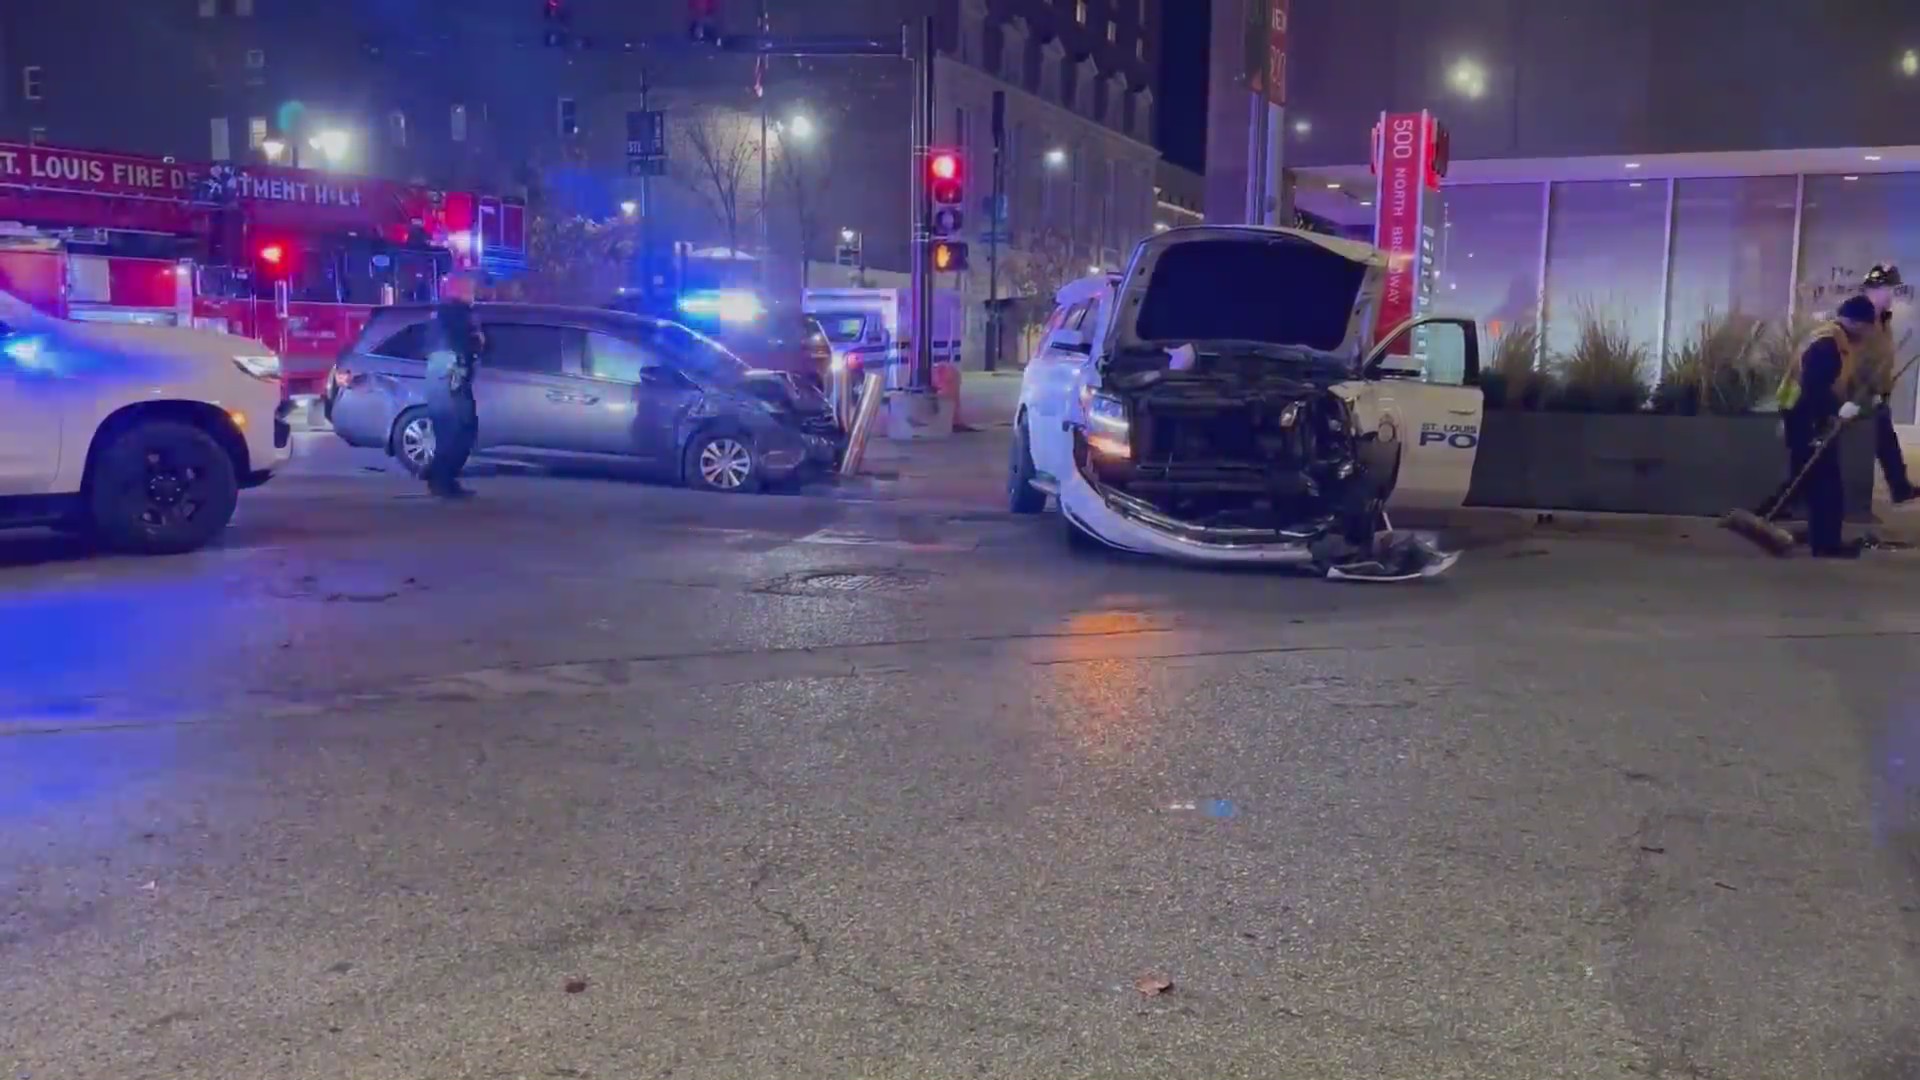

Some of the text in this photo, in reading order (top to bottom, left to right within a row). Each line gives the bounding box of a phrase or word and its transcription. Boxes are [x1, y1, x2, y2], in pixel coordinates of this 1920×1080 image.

[0, 151, 21, 175] T.
[30, 154, 104, 182] LOUIS
[112, 163, 164, 187] FIRE
[170, 169, 308, 202] DETMENT
[1387, 119, 1413, 304] 500 NORTH BROWAY
[1421, 423, 1477, 433] ST. LOUIS
